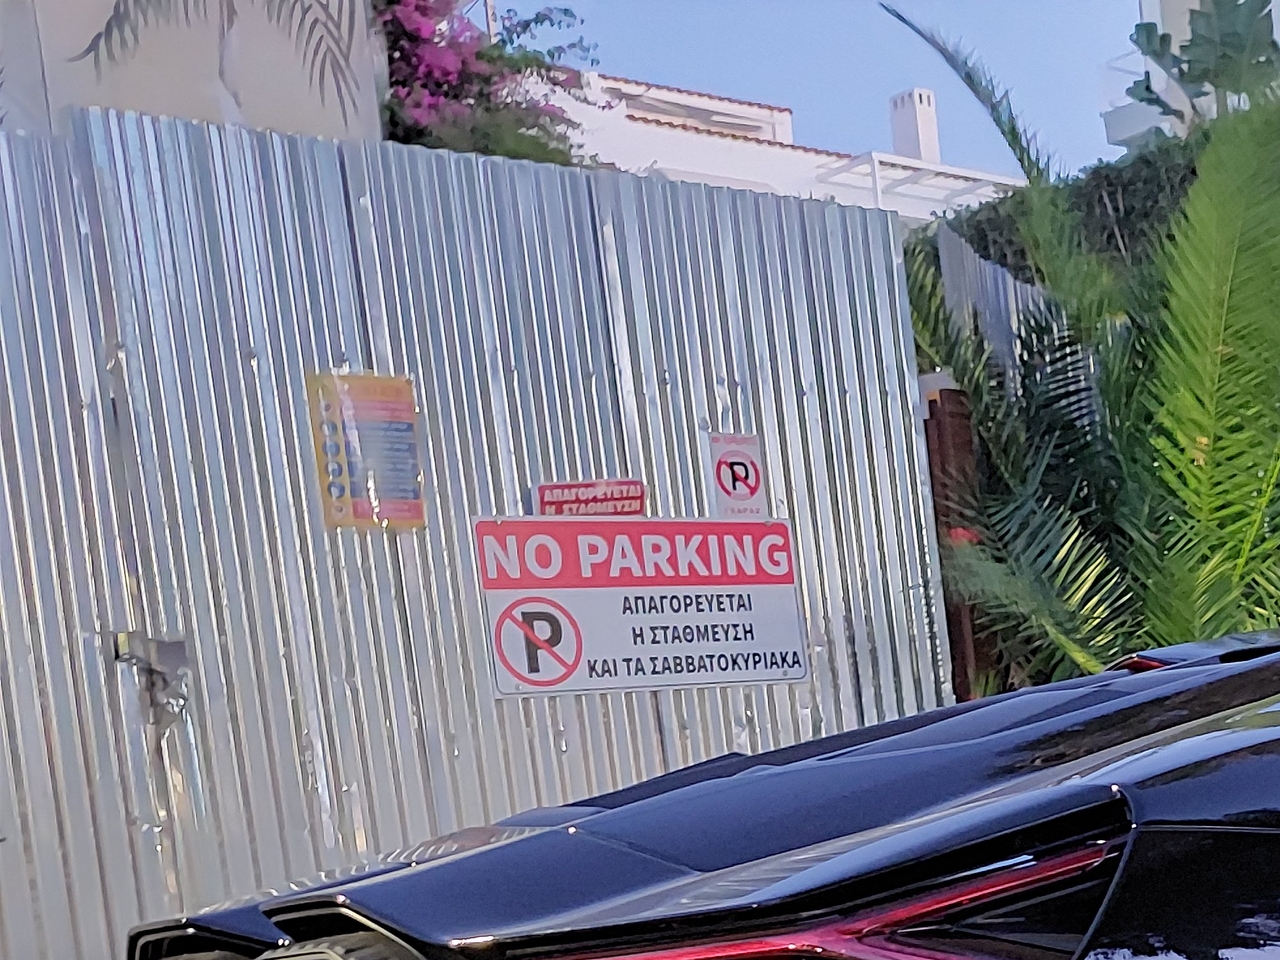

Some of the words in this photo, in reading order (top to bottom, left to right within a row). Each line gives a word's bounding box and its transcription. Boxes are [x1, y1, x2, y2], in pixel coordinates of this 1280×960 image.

[482, 533, 563, 580] NO
[578, 531, 790, 578] PARKING
[622, 593, 753, 615] ΑΠΑΓΟΡΕΥΕΤΑΙ
[650, 623, 755, 645] ΣΤΑΘΜΕΥΣΗ
[587, 657, 618, 678] ΚΑΙ
[622, 656, 646, 676] ΤΑ
[649, 650, 802, 676] ΣΑΒΒΑΤΟΚΥΡΙΑΚΑ
